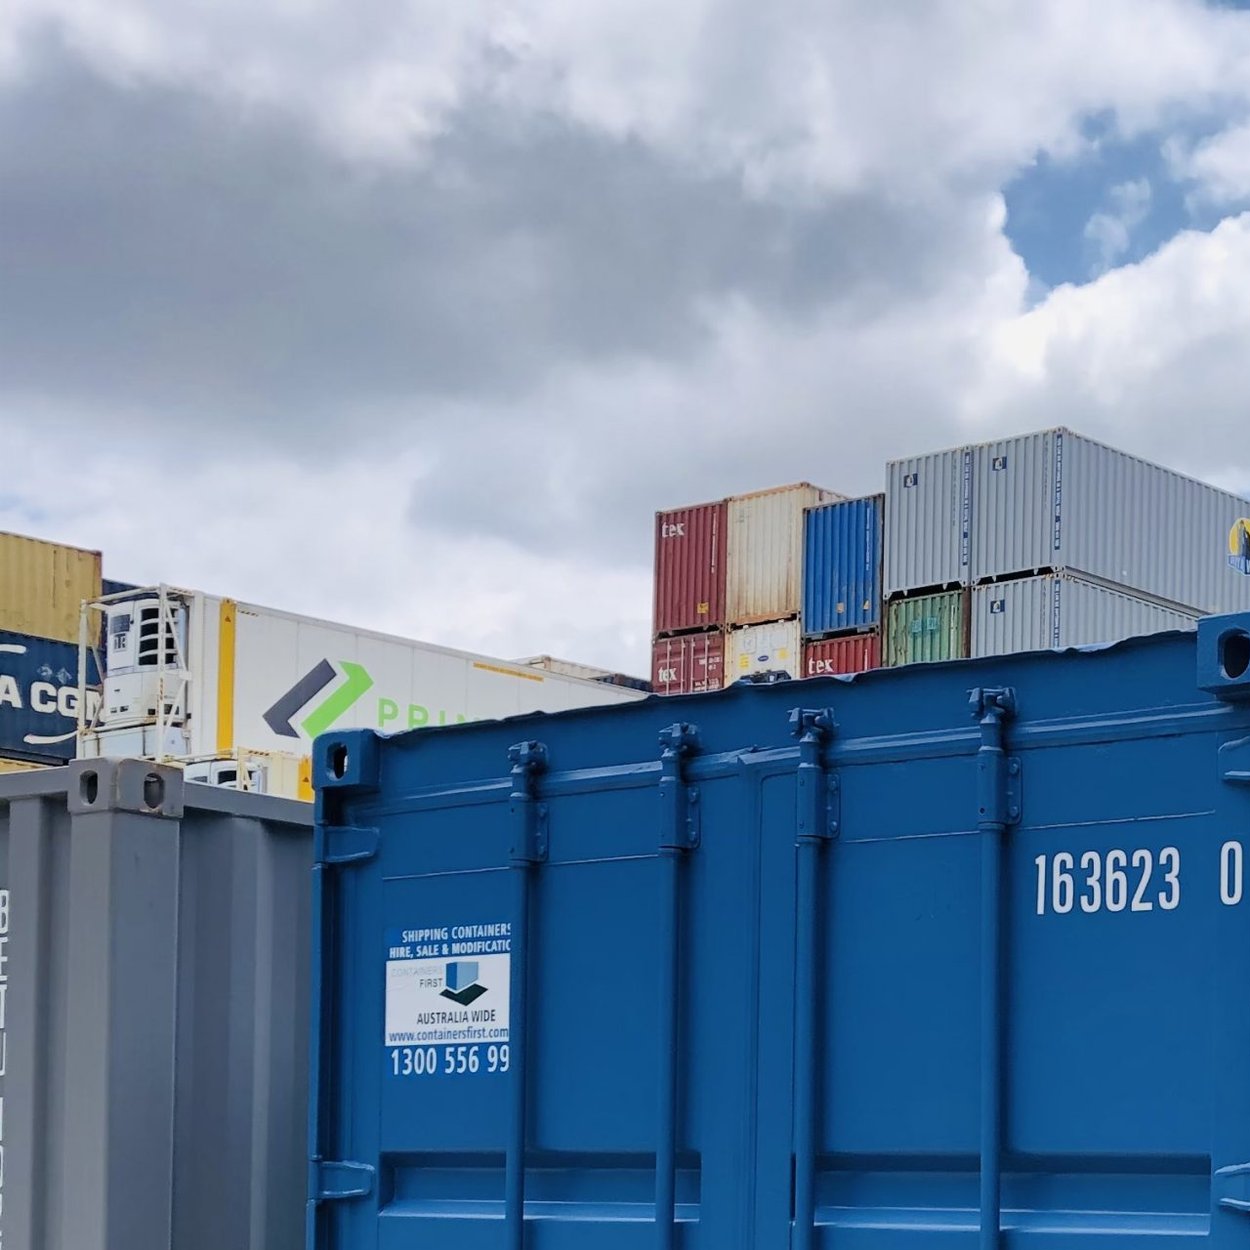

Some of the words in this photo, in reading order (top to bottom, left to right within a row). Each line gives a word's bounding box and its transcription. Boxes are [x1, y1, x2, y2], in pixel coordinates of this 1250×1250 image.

[662, 522, 684, 537] tex
[808, 657, 833, 674] tex
[658, 666, 677, 682] tex
[1035, 846, 1180, 915] 163623
[1220, 840, 1243, 906] 0
[402, 927, 448, 943] SHIPPING
[389, 947, 413, 959] HIRE,
[416, 944, 439, 957] SALE
[442, 944, 449, 956] &
[419, 978, 442, 988] FIRST
[417, 1012, 469, 1025] AUSTRALIA
[471, 1010, 496, 1022] WIDE
[389, 1026, 509, 1042] www.containersfirst.com
[391, 1047, 437, 1076] 1300
[444, 1045, 480, 1074] 556
